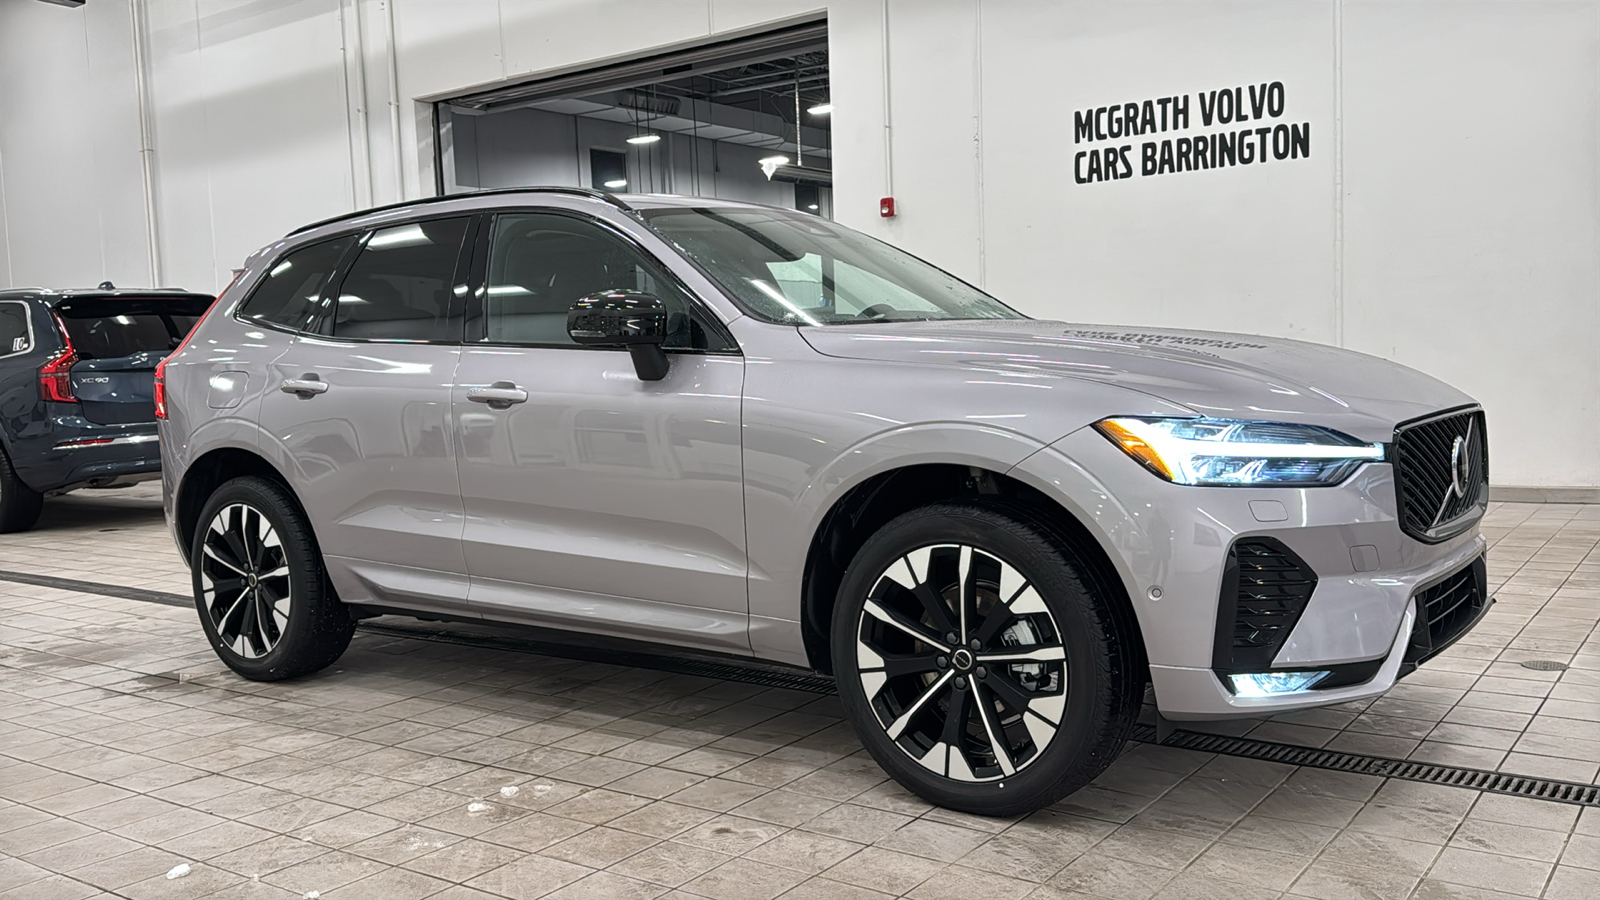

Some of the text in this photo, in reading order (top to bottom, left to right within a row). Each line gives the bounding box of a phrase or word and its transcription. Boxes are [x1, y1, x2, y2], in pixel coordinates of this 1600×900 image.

[1074, 81, 1285, 144] MCGRATH VOLVO
[1074, 122, 1310, 184] CARS BARRINGTON
